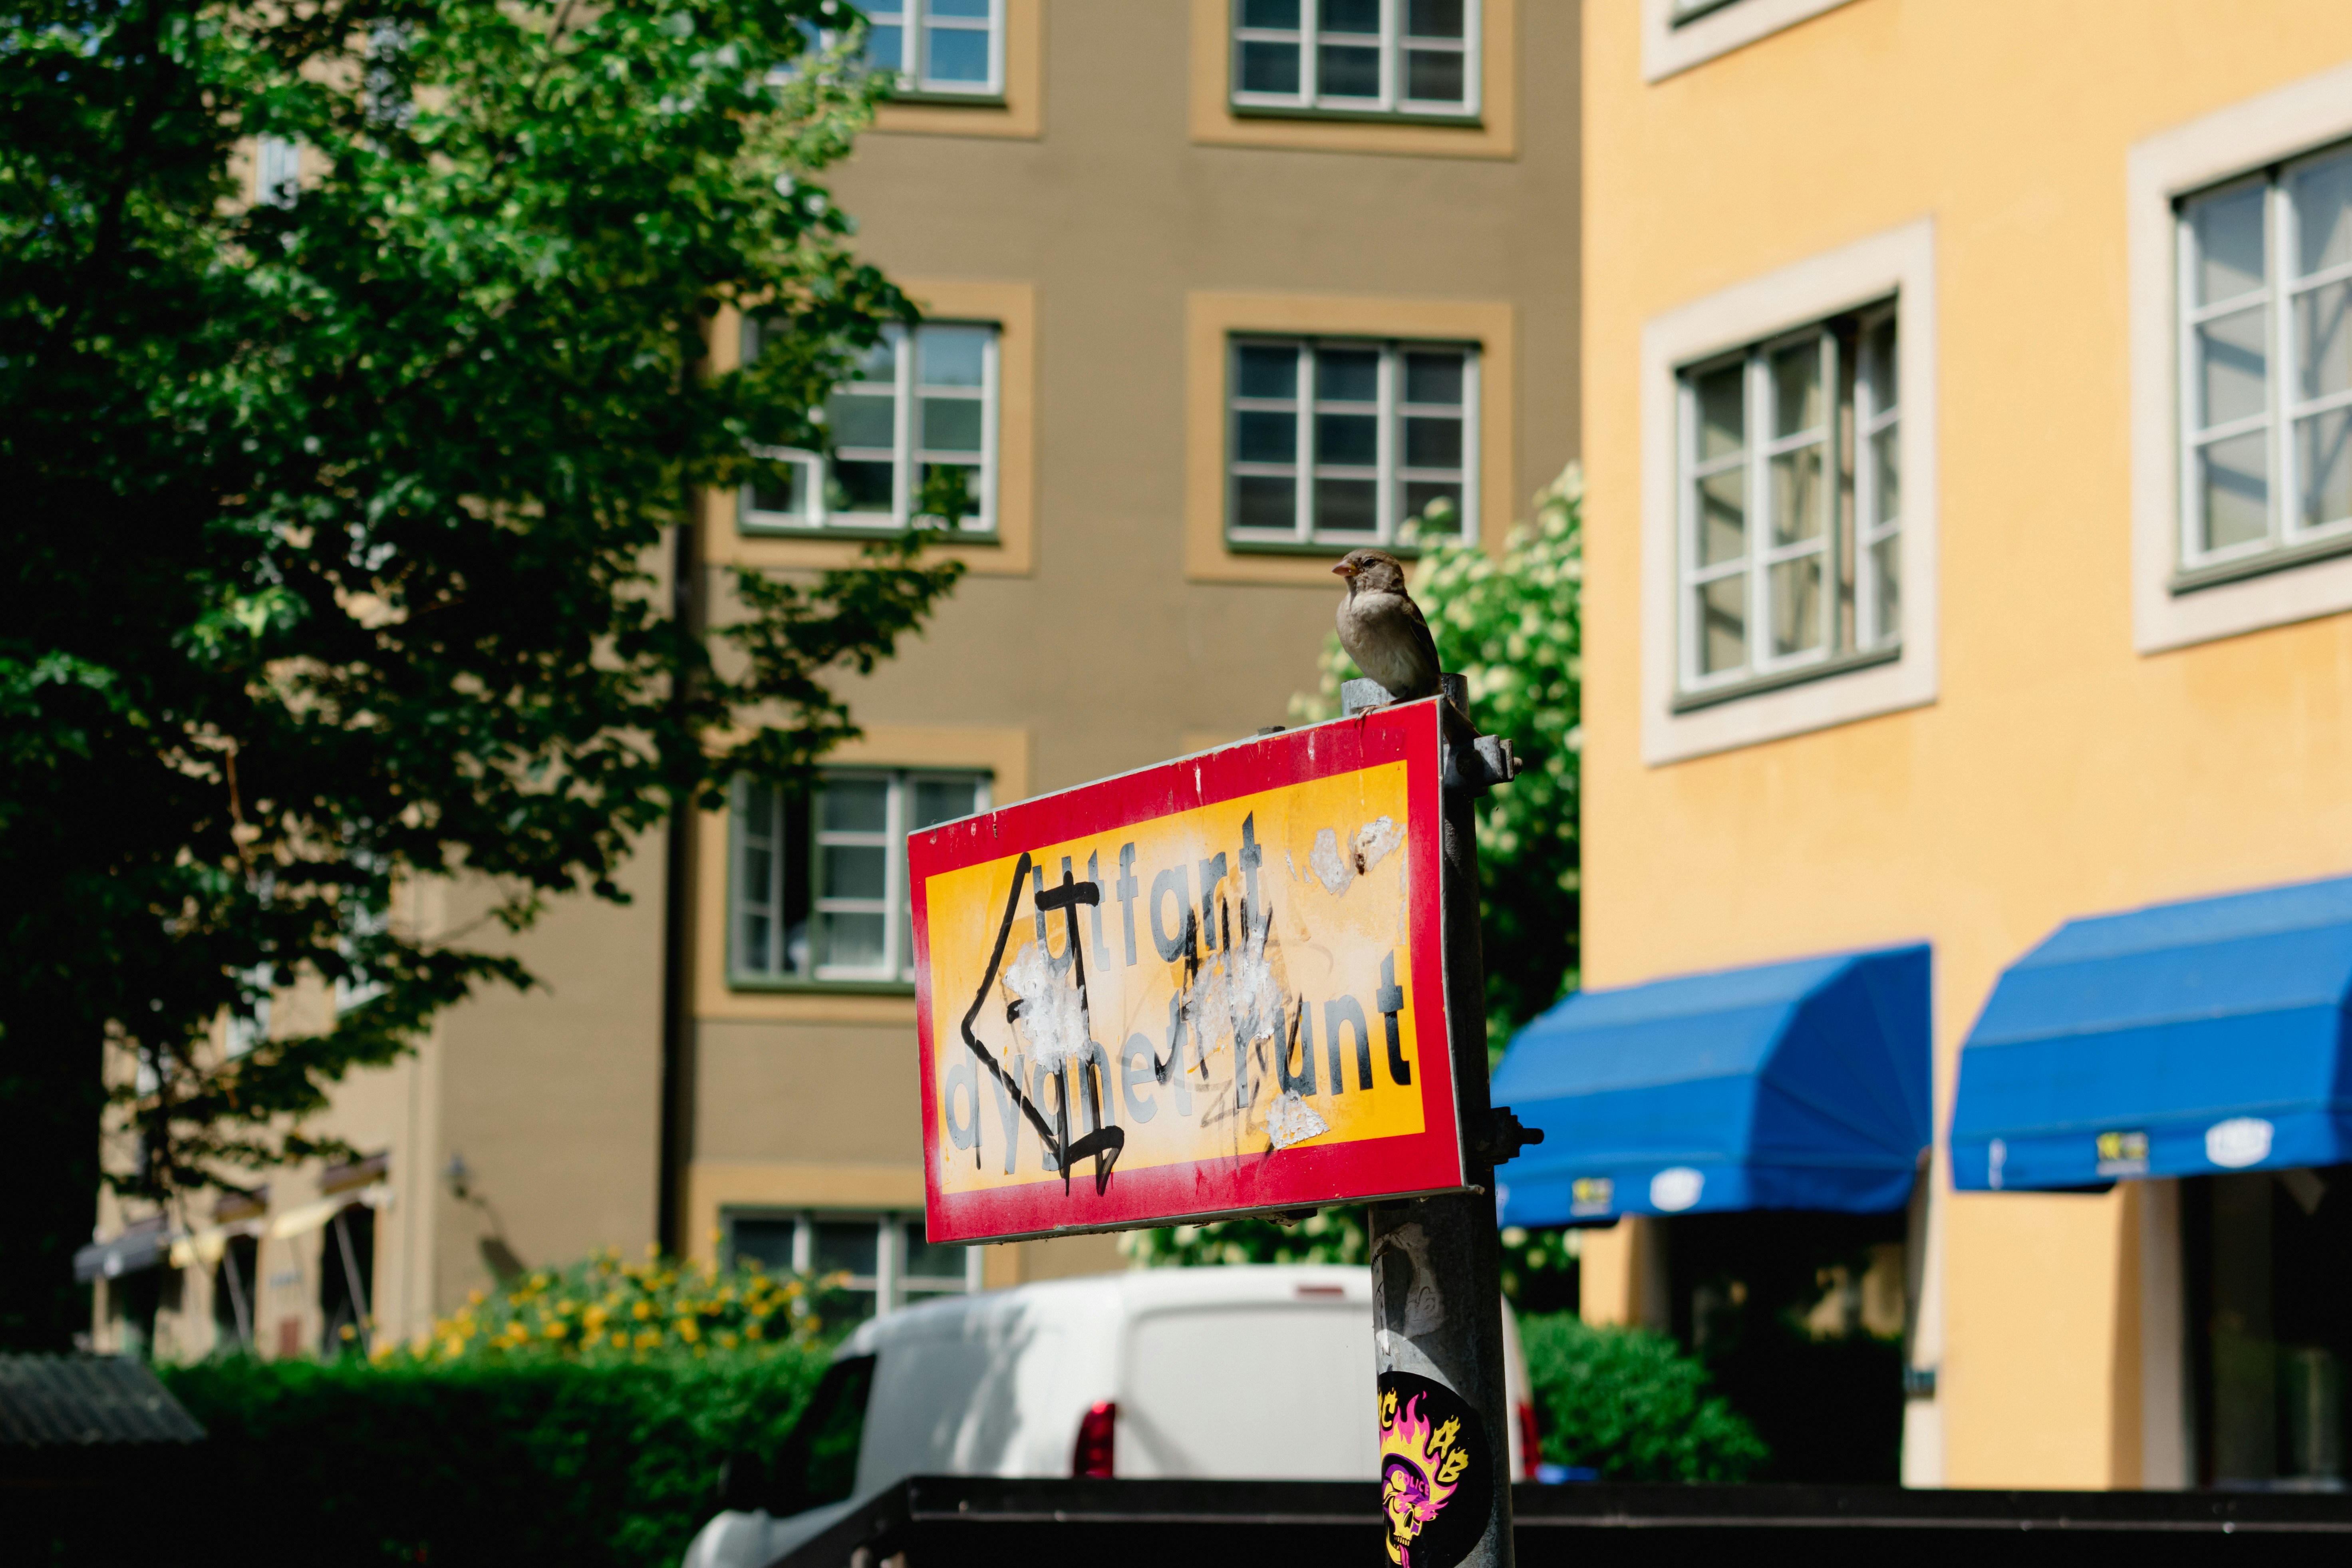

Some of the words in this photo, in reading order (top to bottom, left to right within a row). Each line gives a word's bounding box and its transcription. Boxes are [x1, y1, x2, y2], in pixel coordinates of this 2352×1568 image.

[945, 990, 1192, 1175] dygnet
[1230, 949, 1411, 1109] runt
[1398, 1472, 1429, 1496] POLICE
